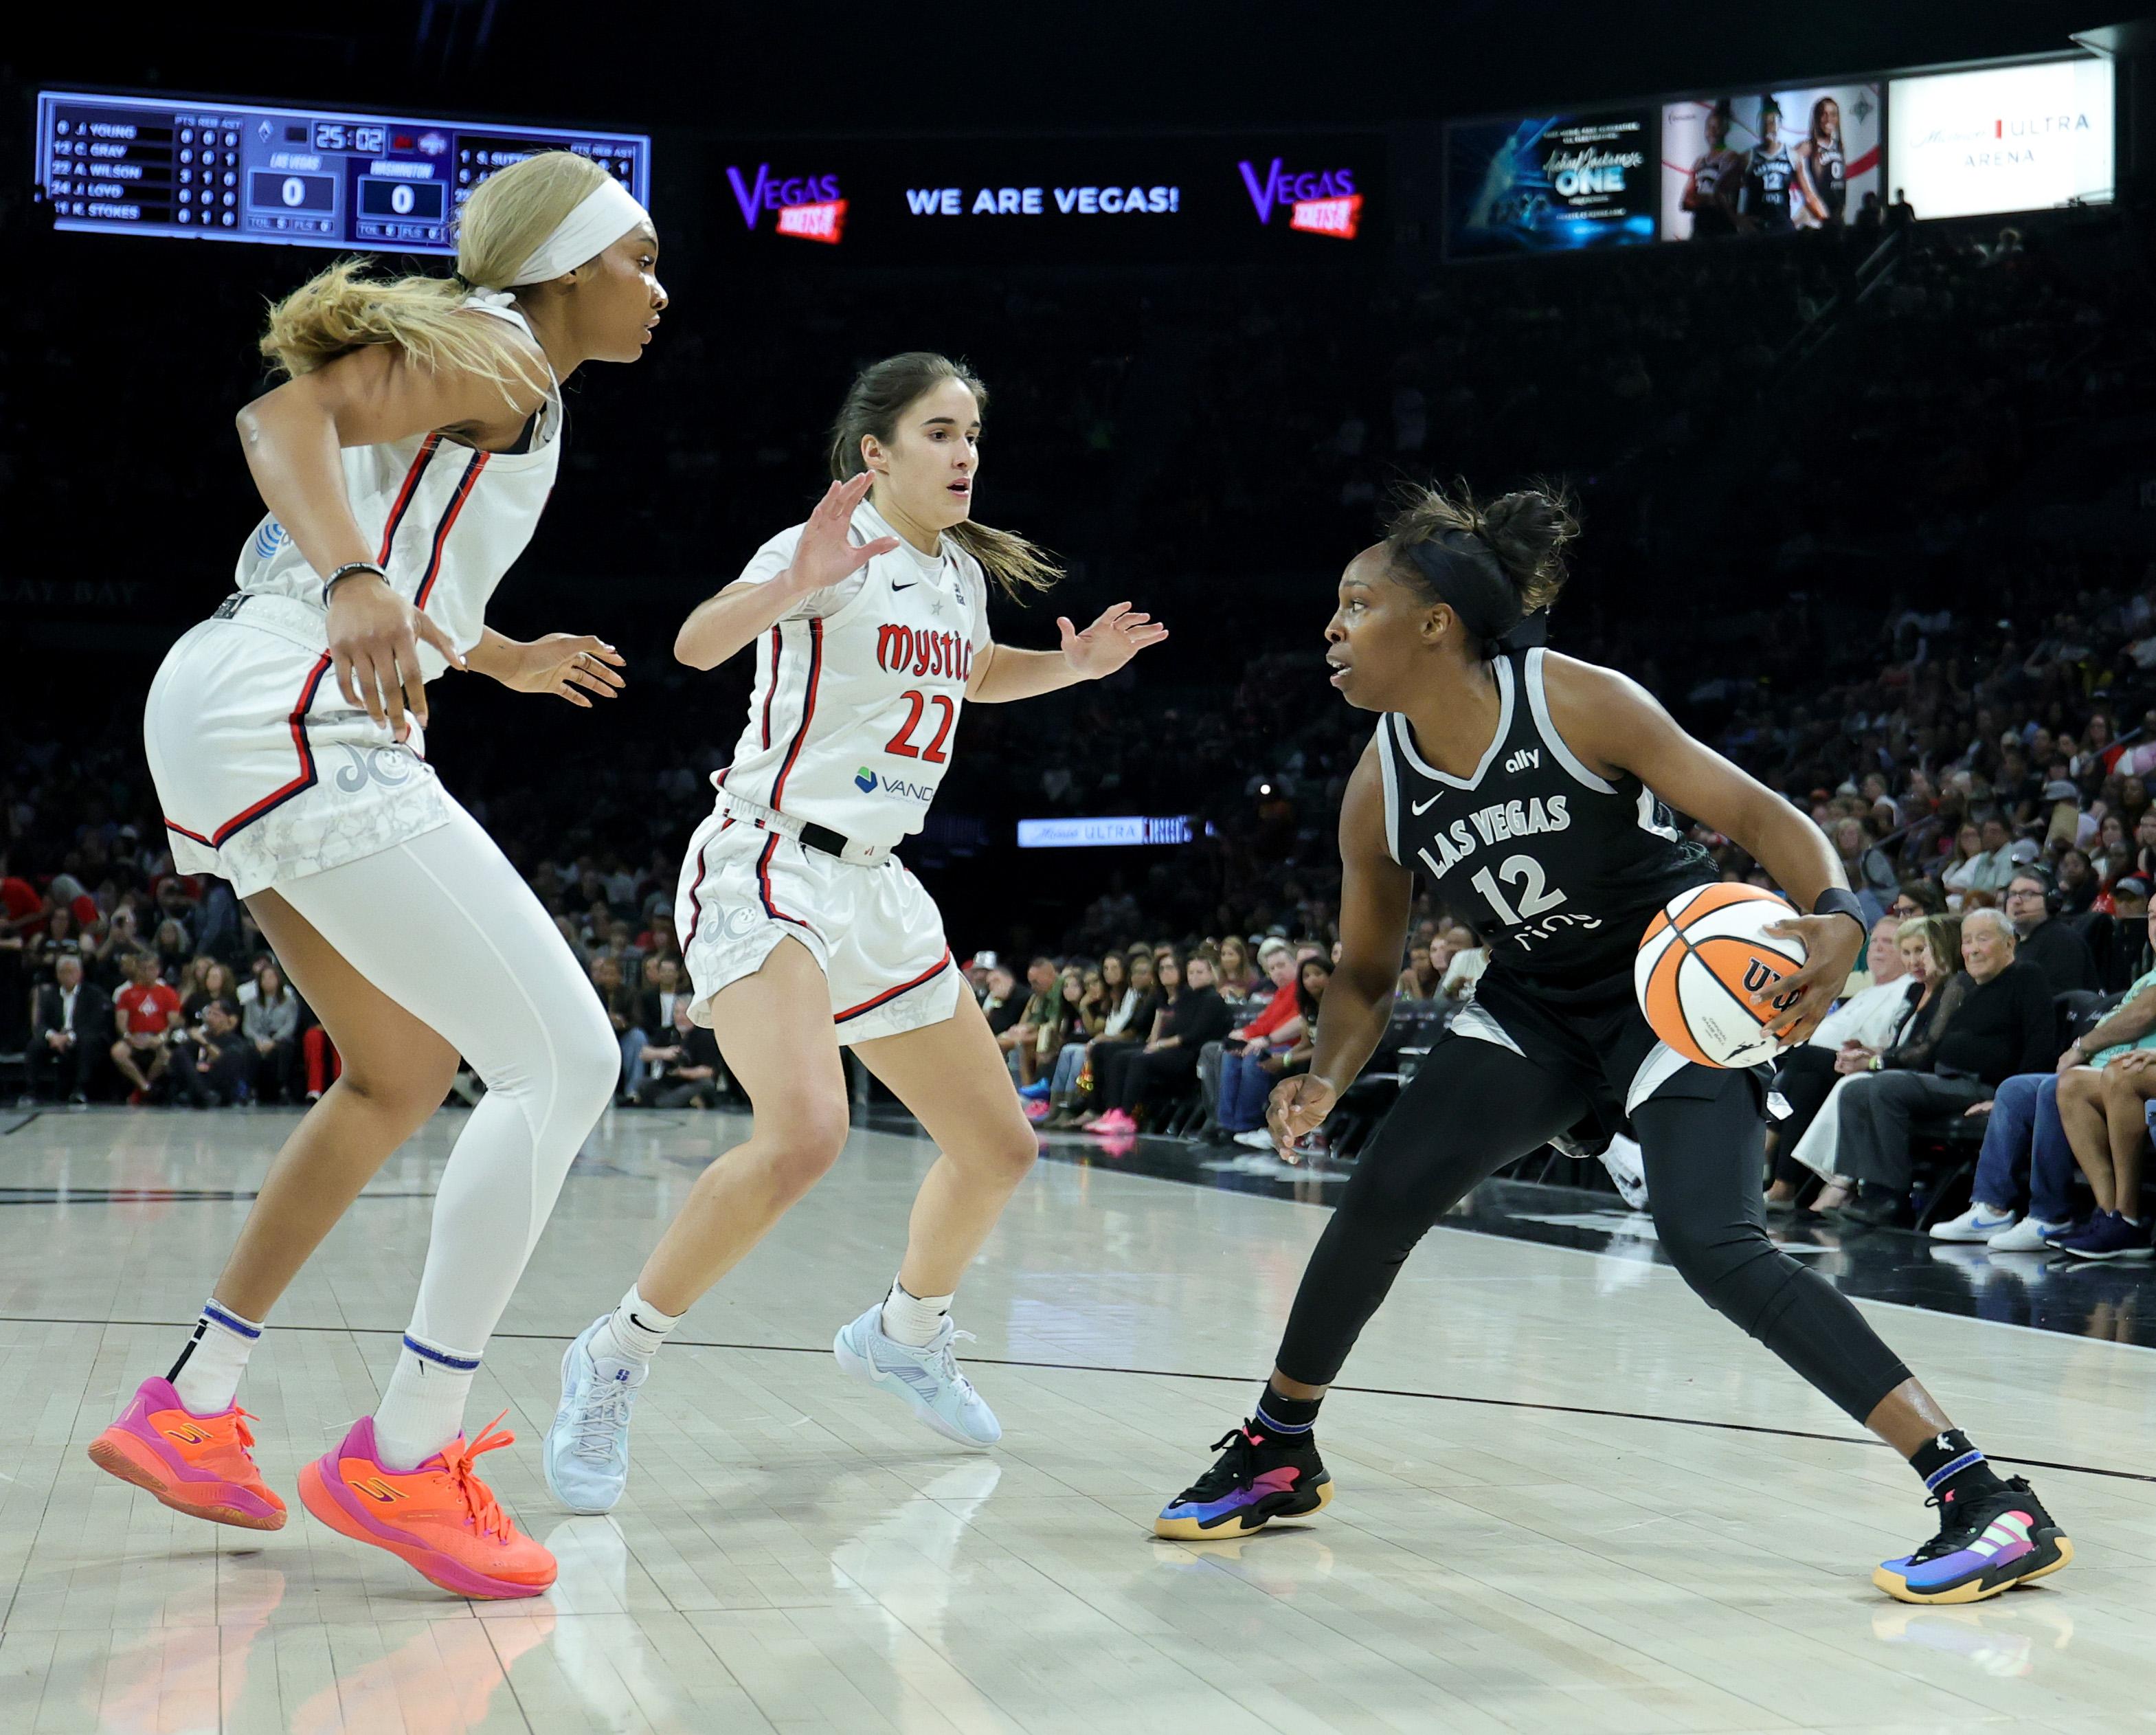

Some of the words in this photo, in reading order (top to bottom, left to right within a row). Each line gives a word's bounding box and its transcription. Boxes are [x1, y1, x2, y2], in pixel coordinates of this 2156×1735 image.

[90, 122, 137, 139] YOUNG
[2010, 113, 2089, 136] ULTRA
[90, 143, 127, 158] GRAY
[317, 124, 385, 152] 25:02
[1964, 149, 2035, 167] ARENA
[90, 163, 143, 180] WILSON
[1555, 166, 1626, 197] ONE
[282, 177, 306, 207] 0
[392, 185, 415, 214] 0
[906, 188, 961, 215] WE
[972, 188, 1044, 215] ARE
[1054, 187, 1180, 214] VEGAS!
[89, 203, 140, 220] STOKES
[884, 690, 954, 764] 22
[1505, 748, 1539, 774] ally
[882, 775, 934, 801] VAND
[1084, 825, 1136, 840] ULTRA
[1417, 820, 1476, 880] LAS
[1469, 795, 1571, 846] VEGAS
[1470, 854, 1568, 926] 12
